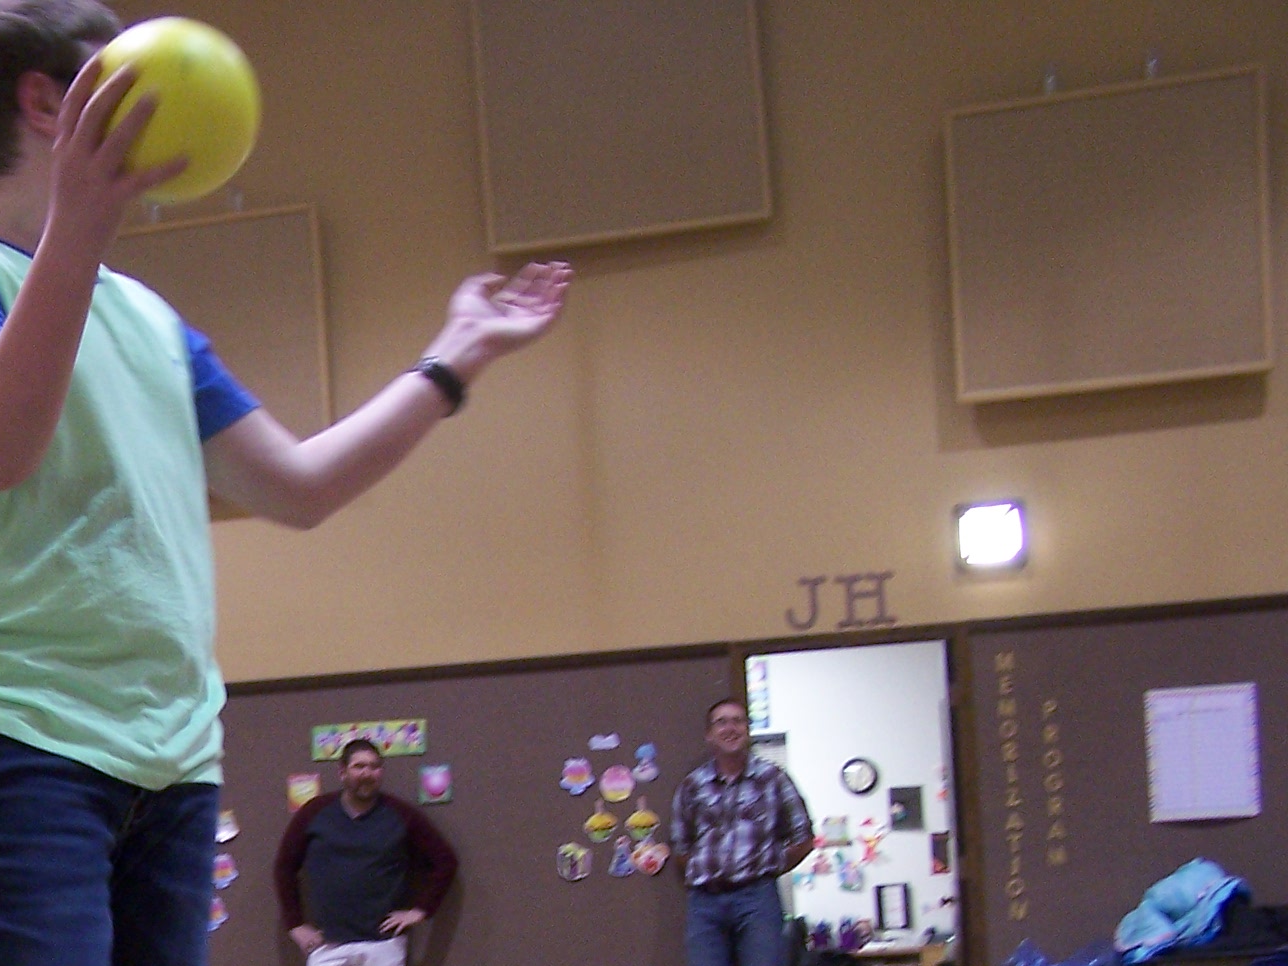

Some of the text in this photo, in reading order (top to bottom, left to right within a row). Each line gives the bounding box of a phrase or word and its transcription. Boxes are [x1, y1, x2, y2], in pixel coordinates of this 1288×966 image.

[784, 570, 896, 631] JH
[994, 650, 1029, 921] MEMORIZATION
[1041, 698, 1069, 867] PROGRAM
